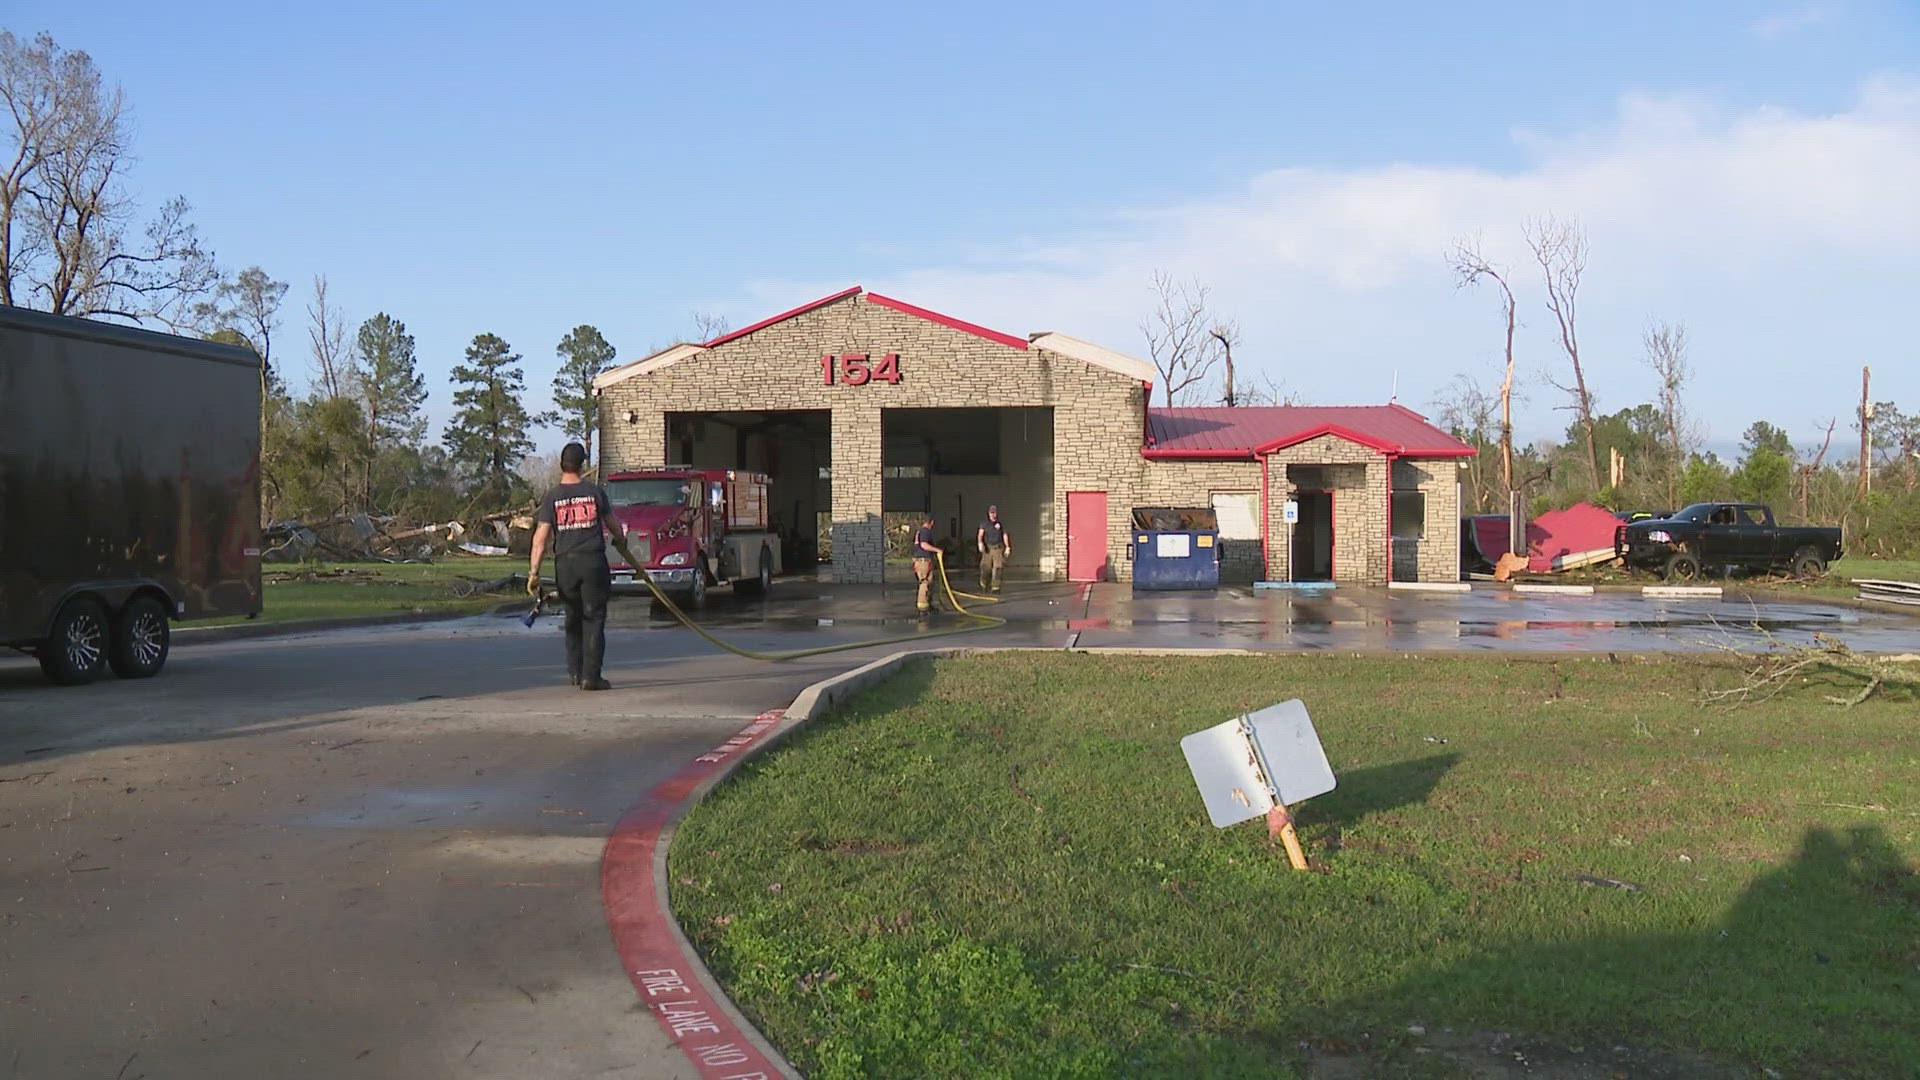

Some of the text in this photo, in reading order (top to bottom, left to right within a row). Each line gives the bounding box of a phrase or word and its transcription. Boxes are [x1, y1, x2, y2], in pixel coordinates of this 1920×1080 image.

[820, 352, 902, 386] 154
[556, 503, 597, 525] FIRE
[636, 968, 691, 996] FIRE
[658, 1000, 720, 1038] LANE
[693, 1043, 748, 1066] NO
